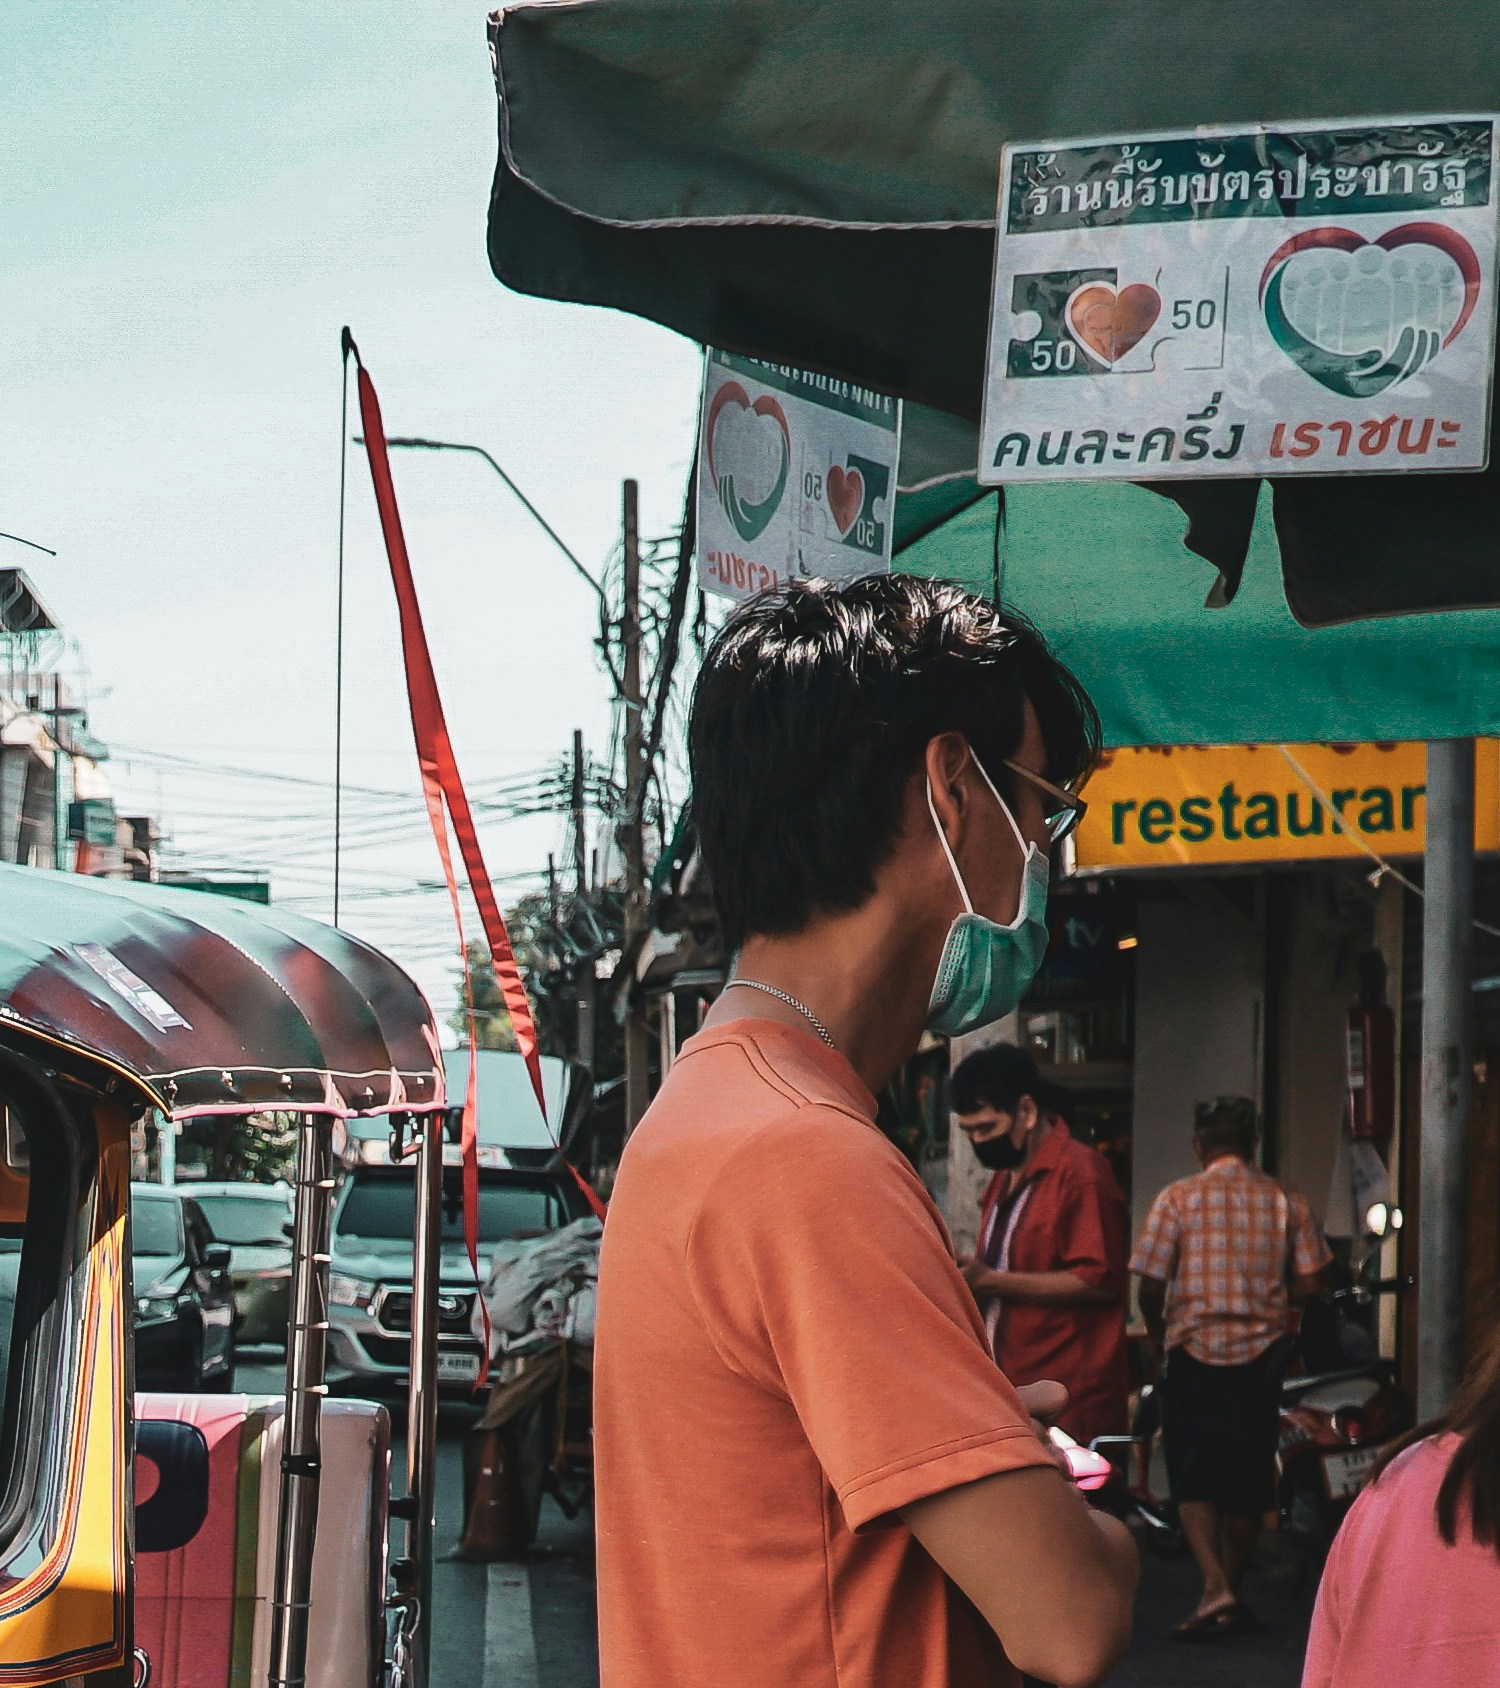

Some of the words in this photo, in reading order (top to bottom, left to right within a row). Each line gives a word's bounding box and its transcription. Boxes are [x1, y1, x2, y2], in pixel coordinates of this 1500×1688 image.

[1028, 138, 1470, 216] ร้านนี้รับบัตรประชารัฐ
[1171, 299, 1216, 330] 50
[1031, 340, 1077, 371] 50
[992, 391, 1246, 468] คนละครึ่ง
[1269, 412, 1463, 459] เราชนะ
